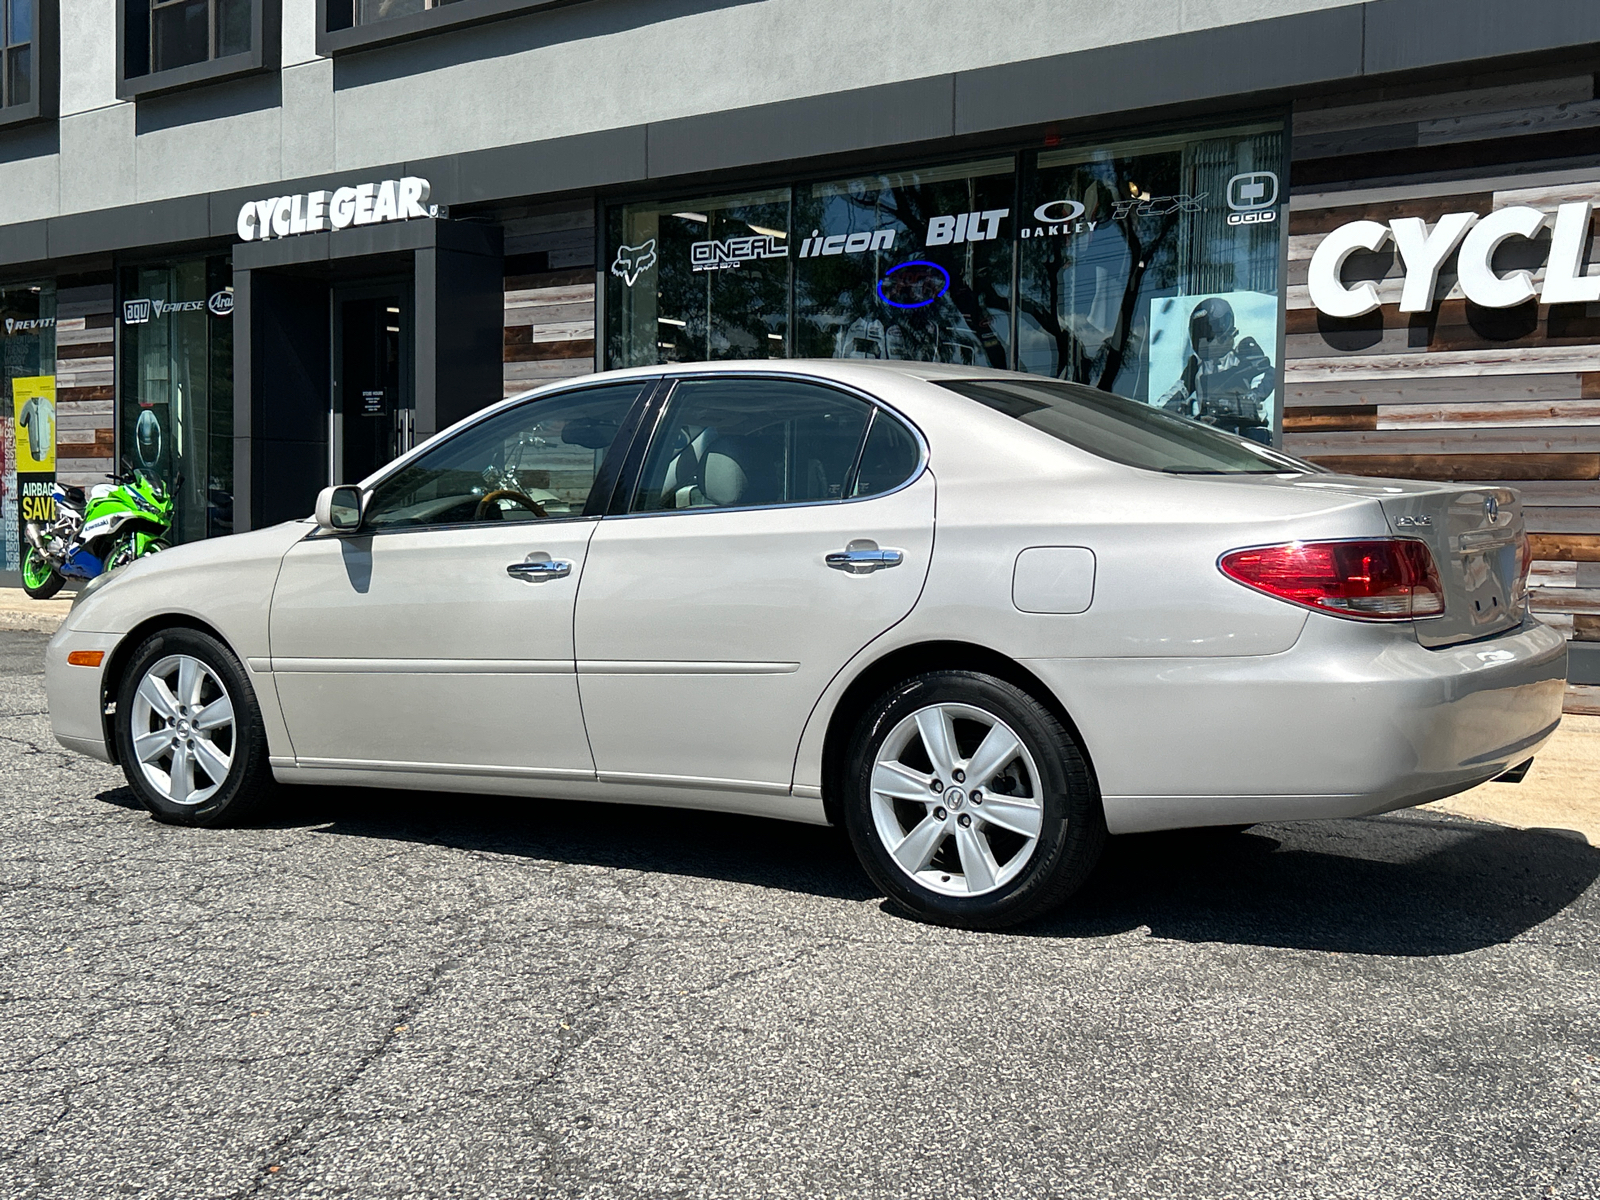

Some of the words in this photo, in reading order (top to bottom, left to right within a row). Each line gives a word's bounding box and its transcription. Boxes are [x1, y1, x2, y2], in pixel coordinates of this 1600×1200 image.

[237, 190, 332, 240] CYCLE
[329, 176, 430, 231] GEAR
[1227, 210, 1276, 225] OGIO
[925, 208, 1010, 247] BILT
[1021, 221, 1098, 239] OAKLEY
[85, 519, 109, 532] Kawasaki
